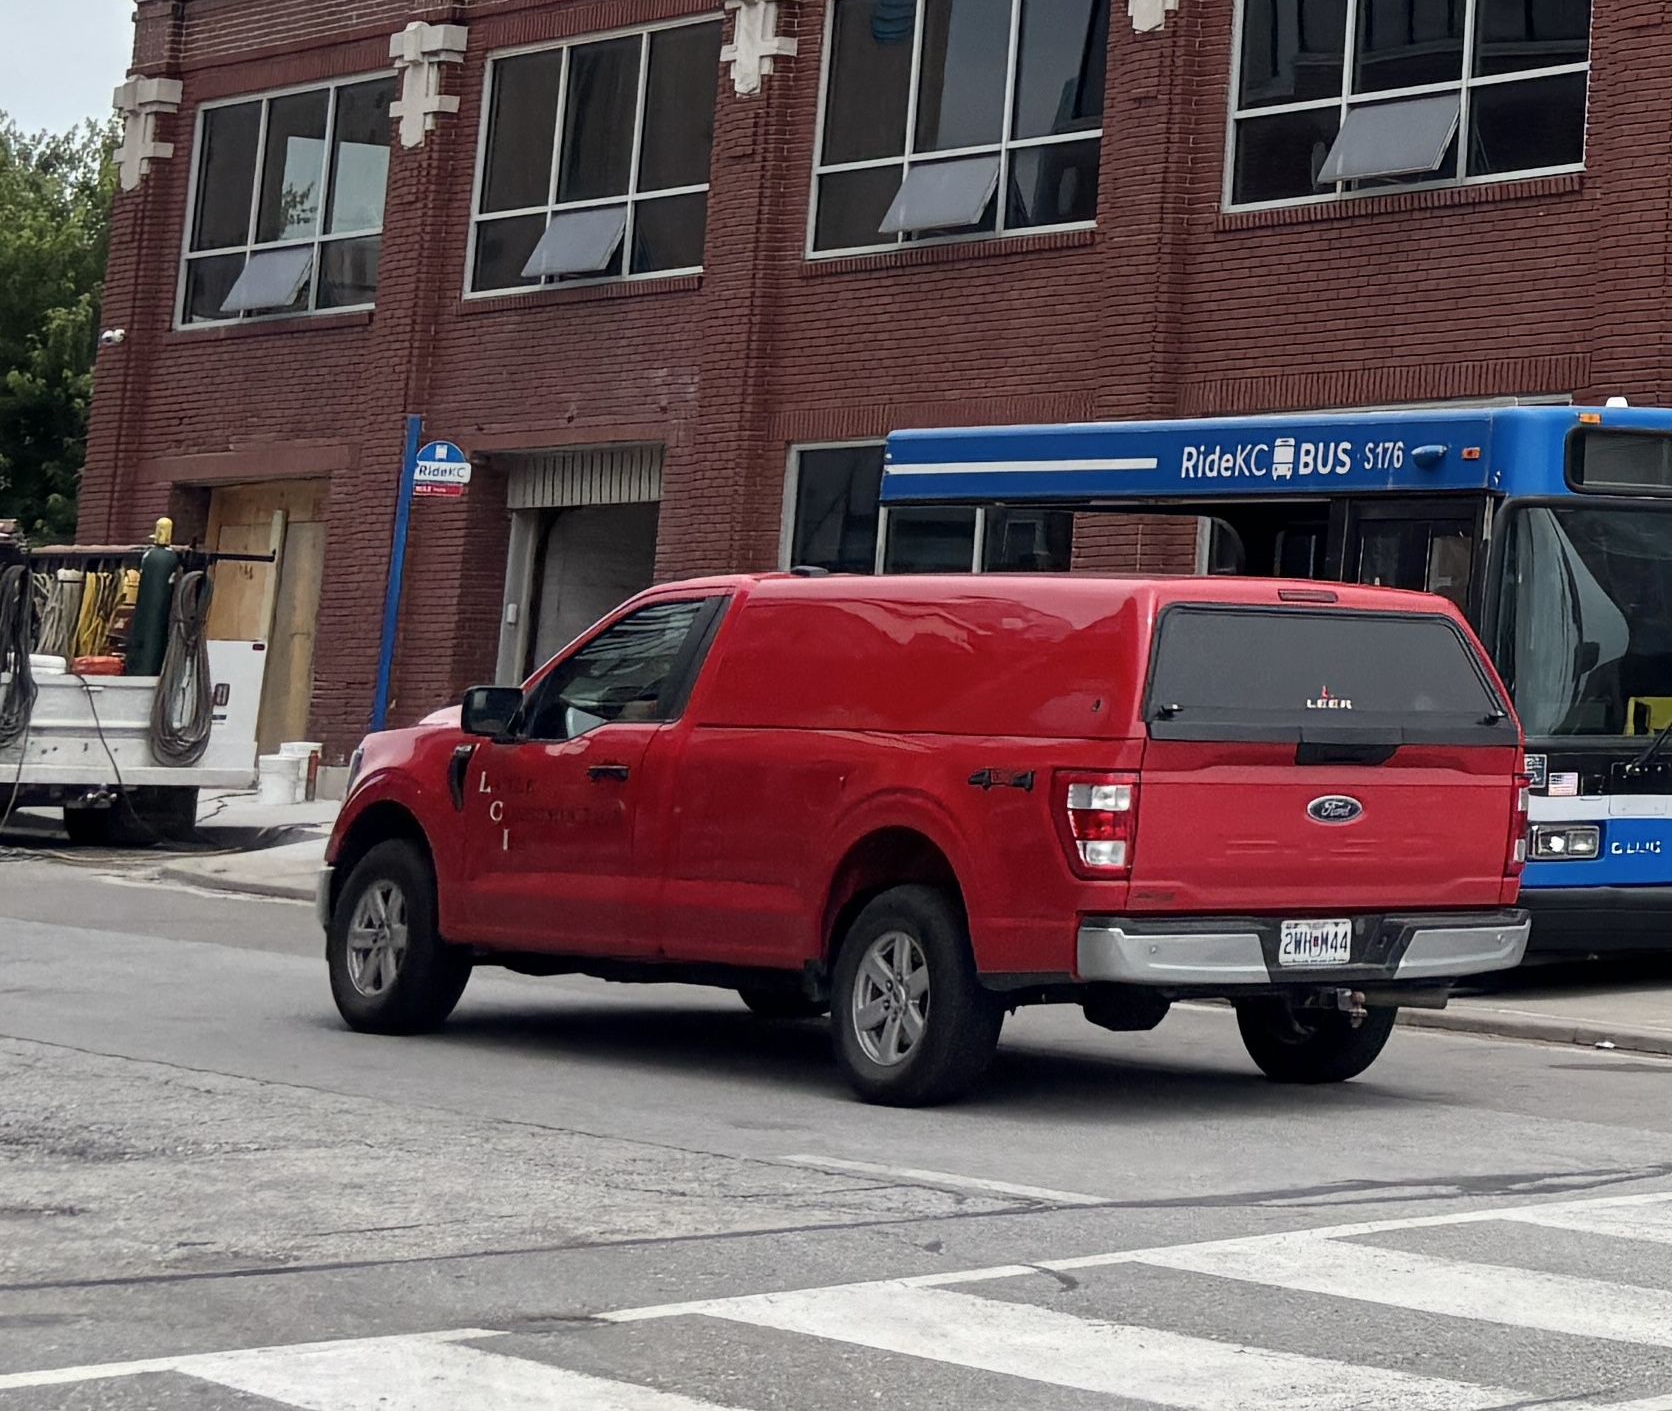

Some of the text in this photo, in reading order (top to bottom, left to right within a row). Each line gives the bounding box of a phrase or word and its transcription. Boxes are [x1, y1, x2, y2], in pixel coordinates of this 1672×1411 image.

[1181, 441, 1404, 479] RideKC BUS S176
[419, 465, 466, 478] RideKC
[1306, 699, 1352, 709] LEER
[1321, 801, 1351, 816] Ford
